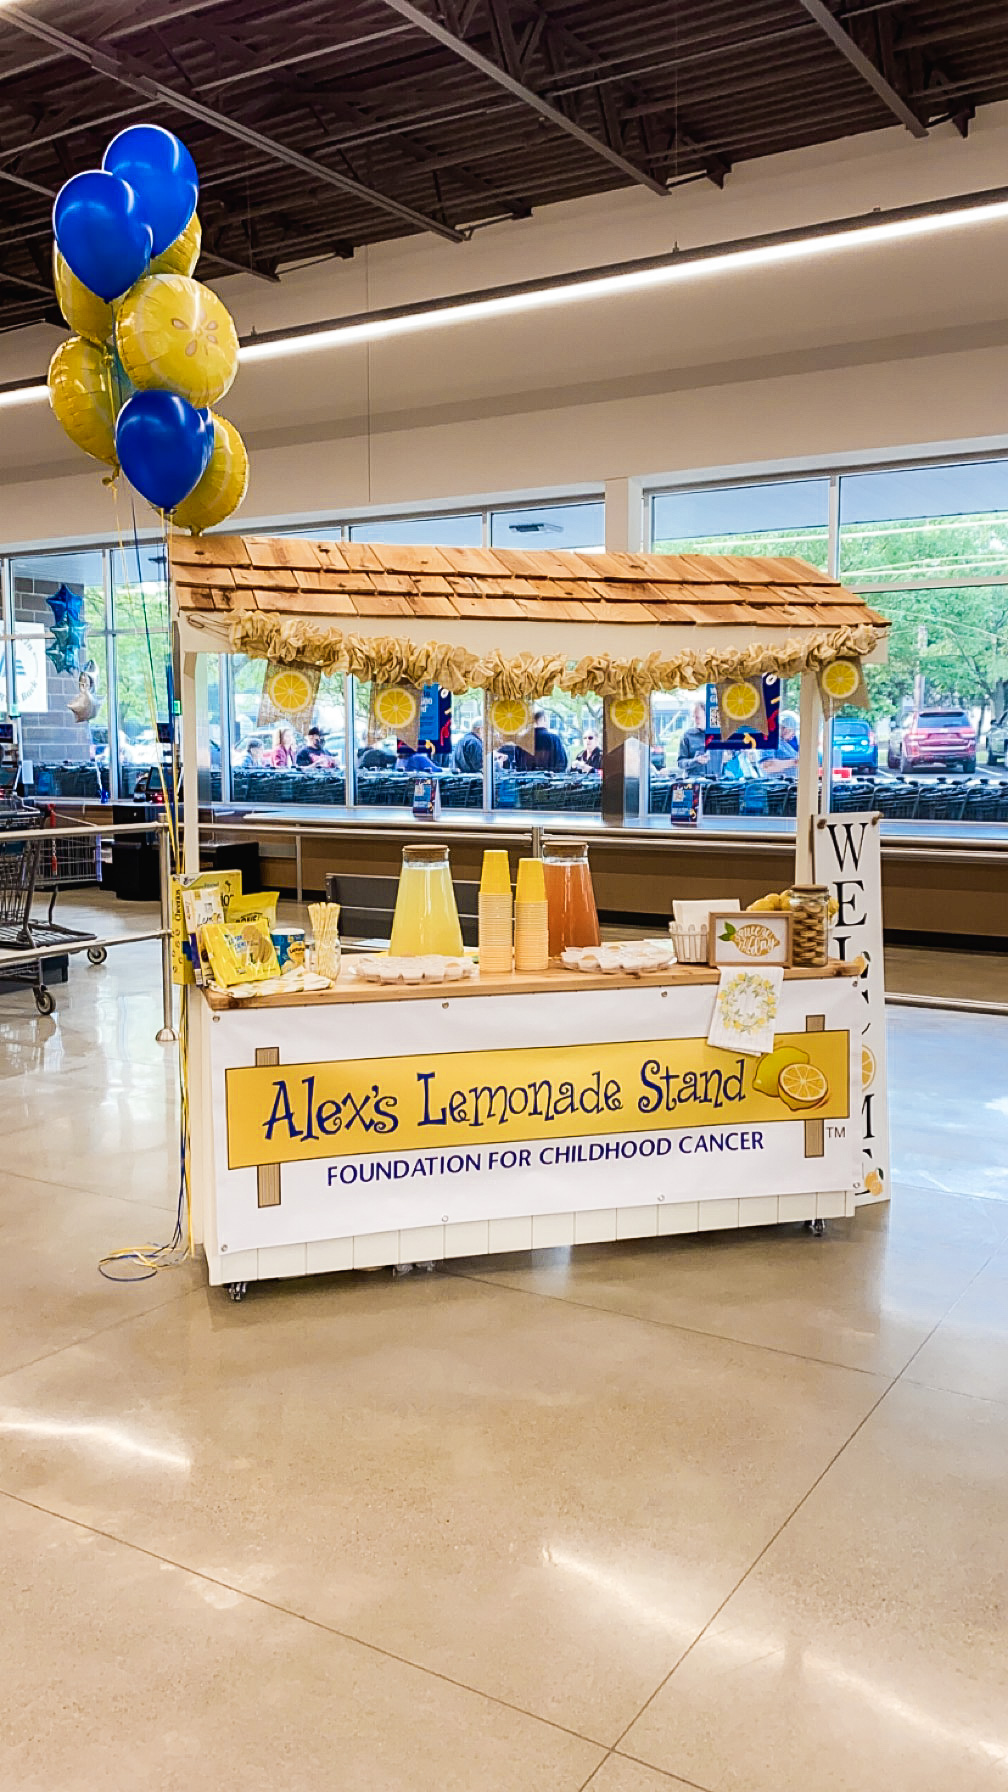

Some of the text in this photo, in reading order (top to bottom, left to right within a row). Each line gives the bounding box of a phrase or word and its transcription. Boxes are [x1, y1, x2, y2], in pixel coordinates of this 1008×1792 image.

[262, 1058, 746, 1142] Alex's Lemonade Stand
[327, 1131, 764, 1186] FOUNDATION FOR CHILDHOOD CANCER
[826, 1127, 846, 1138] TM
